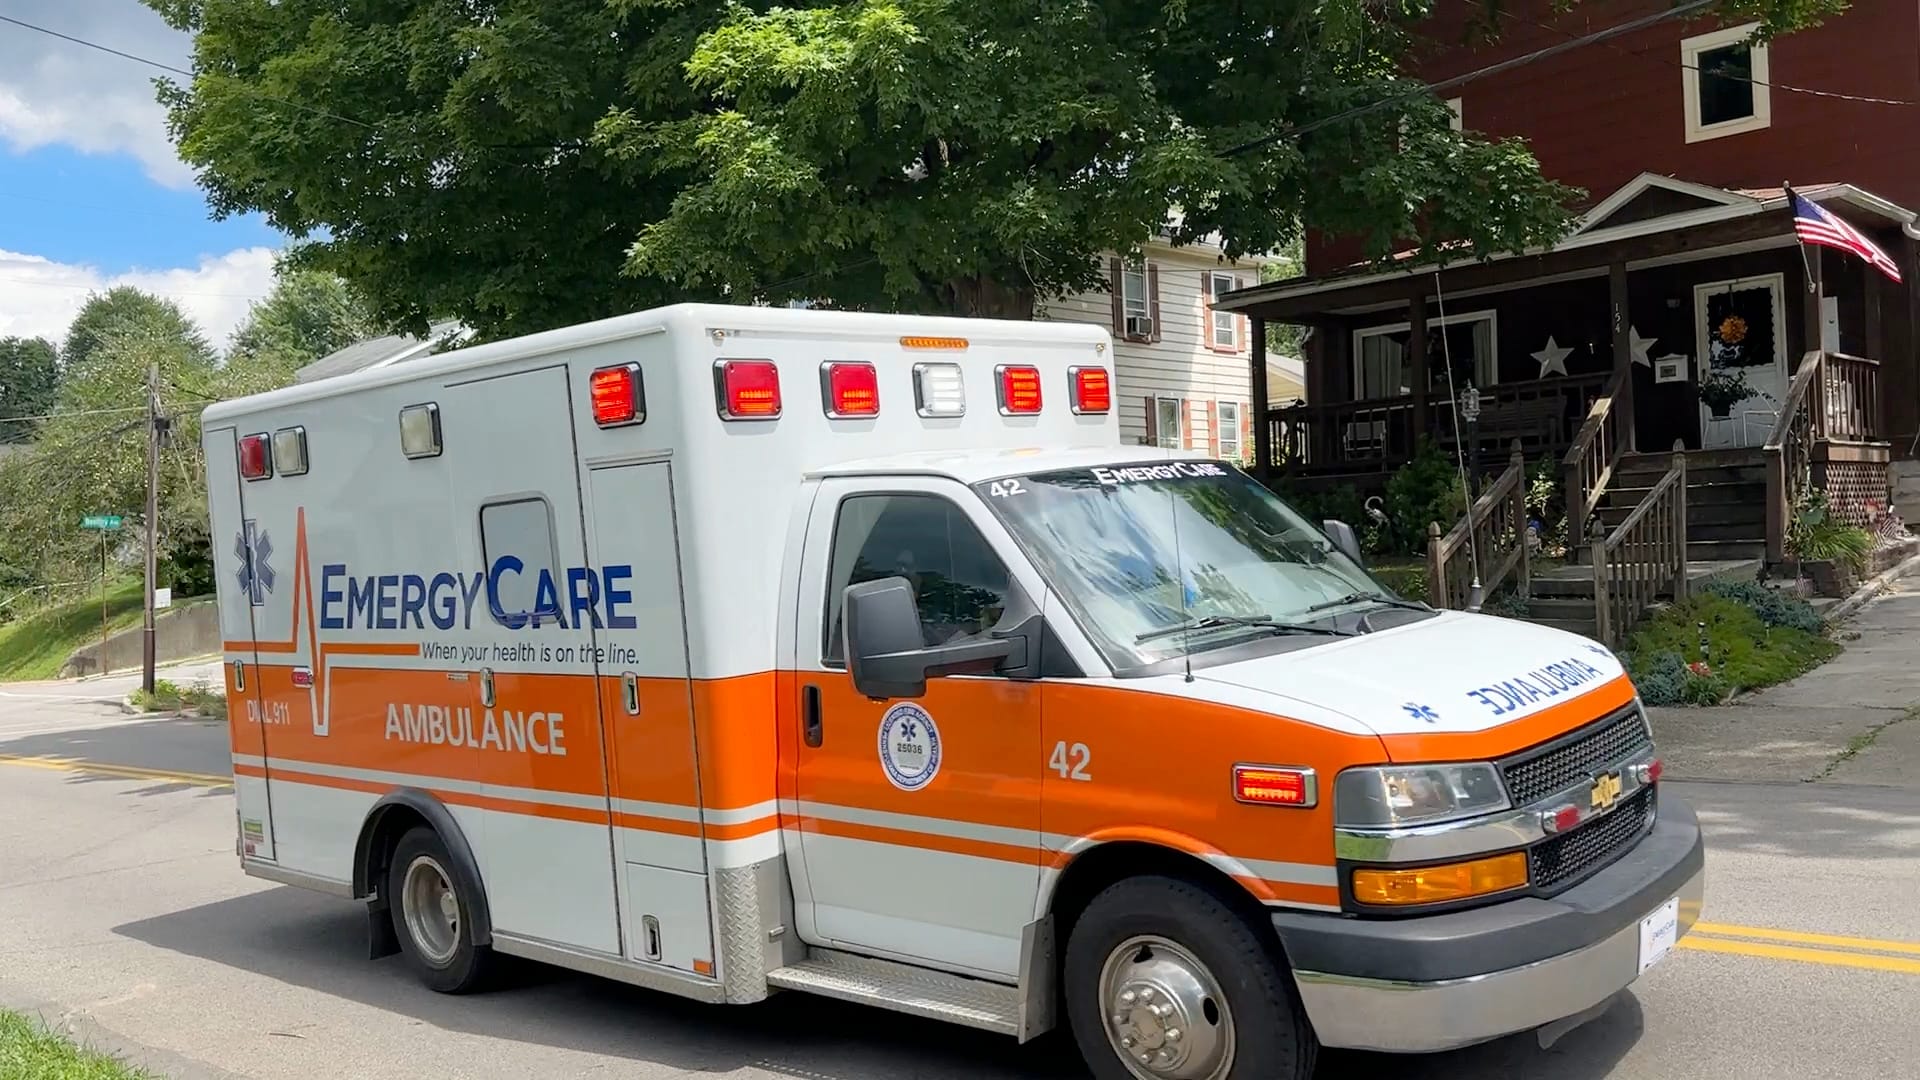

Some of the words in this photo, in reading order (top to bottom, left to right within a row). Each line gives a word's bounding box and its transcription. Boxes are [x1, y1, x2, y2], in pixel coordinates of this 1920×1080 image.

[991, 479, 1027, 497] 42
[422, 642, 457, 660] When
[461, 646, 488, 664] your
[493, 642, 535, 662] health
[540, 643, 551, 662] is
[555, 647, 574, 663] on
[579, 643, 605, 663] the
[608, 642, 639, 664] line.
[273, 701, 290, 725] 911
[384, 703, 567, 755] AMBULANCE
[1048, 740, 1092, 781] 42
